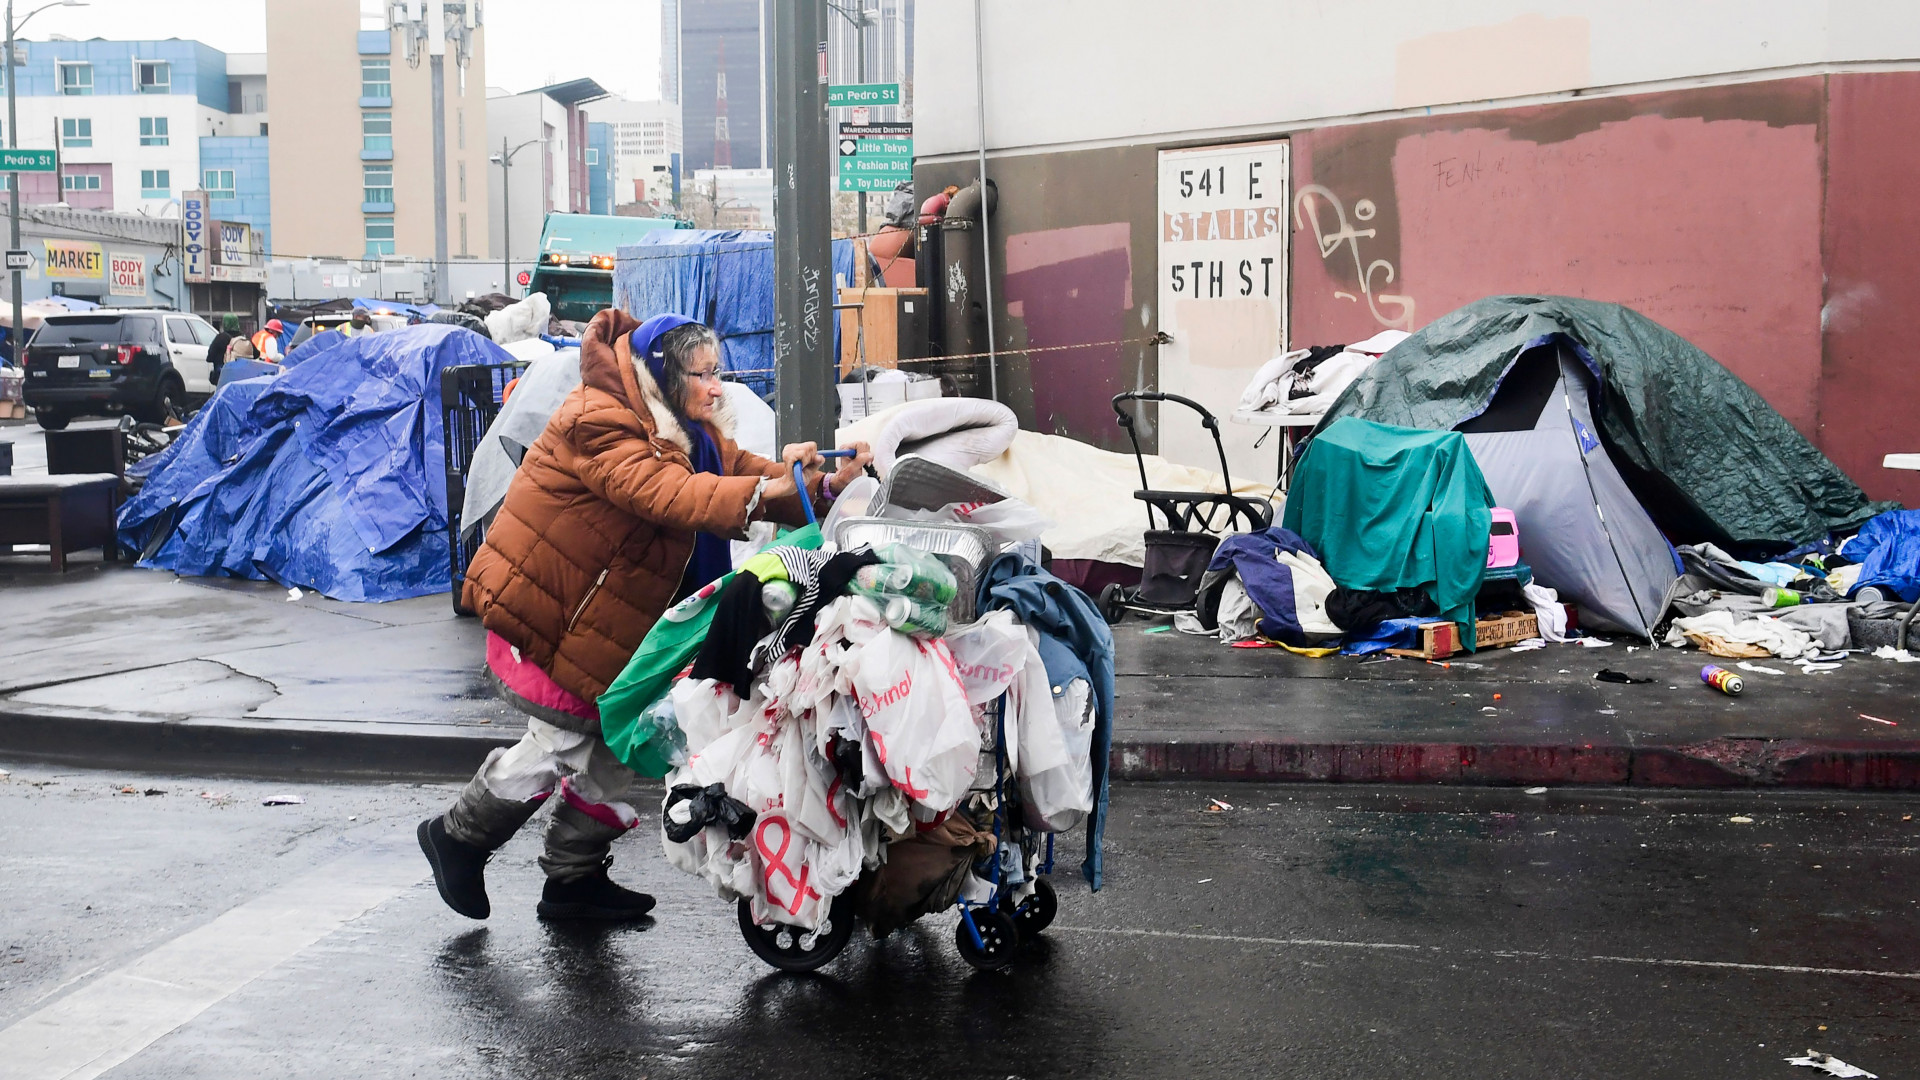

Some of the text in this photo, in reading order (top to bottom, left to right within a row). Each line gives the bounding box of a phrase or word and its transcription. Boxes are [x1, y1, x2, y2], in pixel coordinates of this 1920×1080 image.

[847, 91, 878, 100] Pedro
[882, 90, 895, 99] St
[843, 126, 912, 134] WAREHOUSE DISTRICT
[857, 143, 908, 154] Little Tokyo
[4, 155, 51, 165] Pedro St
[857, 161, 908, 170] Fashion Dist
[857, 178, 871, 189] Toy
[1180, 162, 1262, 200] 541 E
[185, 200, 202, 241] BODY
[1170, 208, 1278, 242] STAIRS
[221, 225, 244, 243] BODY
[9, 256, 27, 264] ONE WAY
[47, 250, 101, 270] MARKET
[186, 244, 202, 275] OIL
[225, 245, 242, 262] OIL
[112, 260, 142, 273] BODY
[119, 274, 137, 286] OIL
[1172, 258, 1273, 298] 5TH ST
